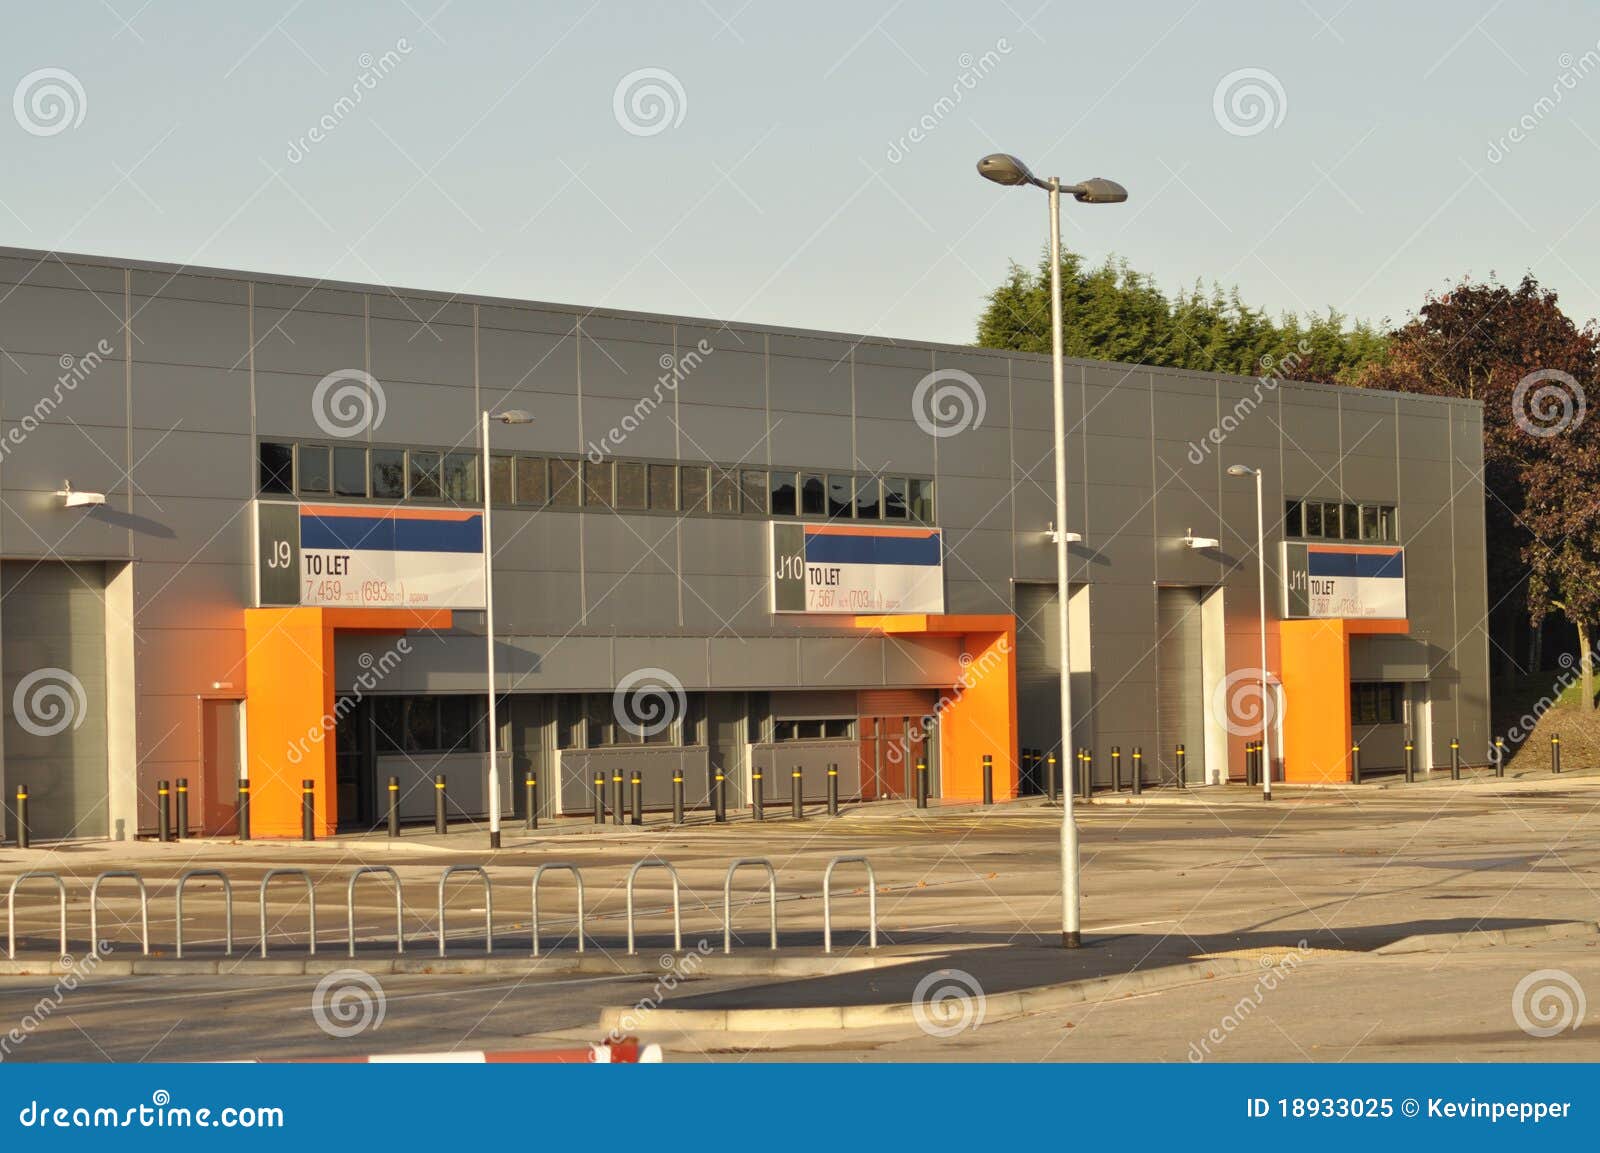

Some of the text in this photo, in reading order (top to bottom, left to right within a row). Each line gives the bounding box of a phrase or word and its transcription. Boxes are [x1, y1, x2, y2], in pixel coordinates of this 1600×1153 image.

[268, 541, 291, 568] J9
[305, 555, 350, 575] TO LET
[777, 556, 803, 580] J10
[809, 568, 840, 585] TO LET
[1290, 570, 1307, 590] J11
[306, 580, 341, 603] 7,459
[1311, 580, 1335, 595] TO LET
